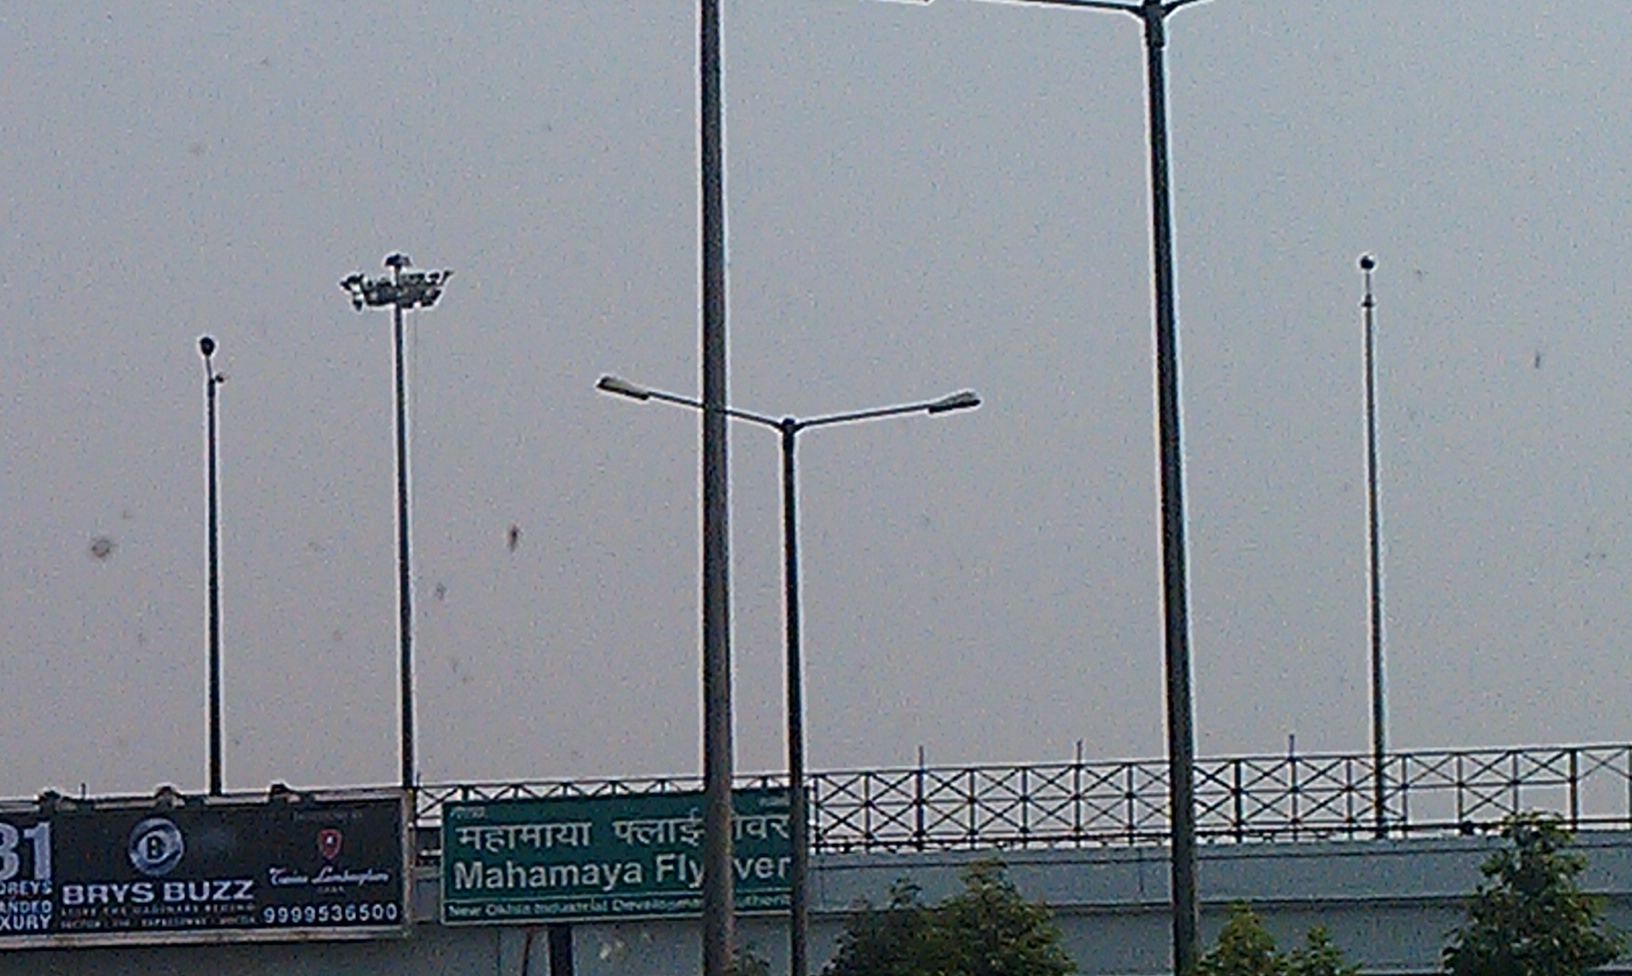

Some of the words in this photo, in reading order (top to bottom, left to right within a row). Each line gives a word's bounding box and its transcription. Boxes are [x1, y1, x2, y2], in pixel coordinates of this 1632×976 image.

[455, 822, 593, 852] महामाया
[453, 860, 643, 891] Mahamaya
[656, 853, 792, 888] Flyver
[62, 882, 155, 905] BRYS
[163, 879, 254, 901] BUZZ
